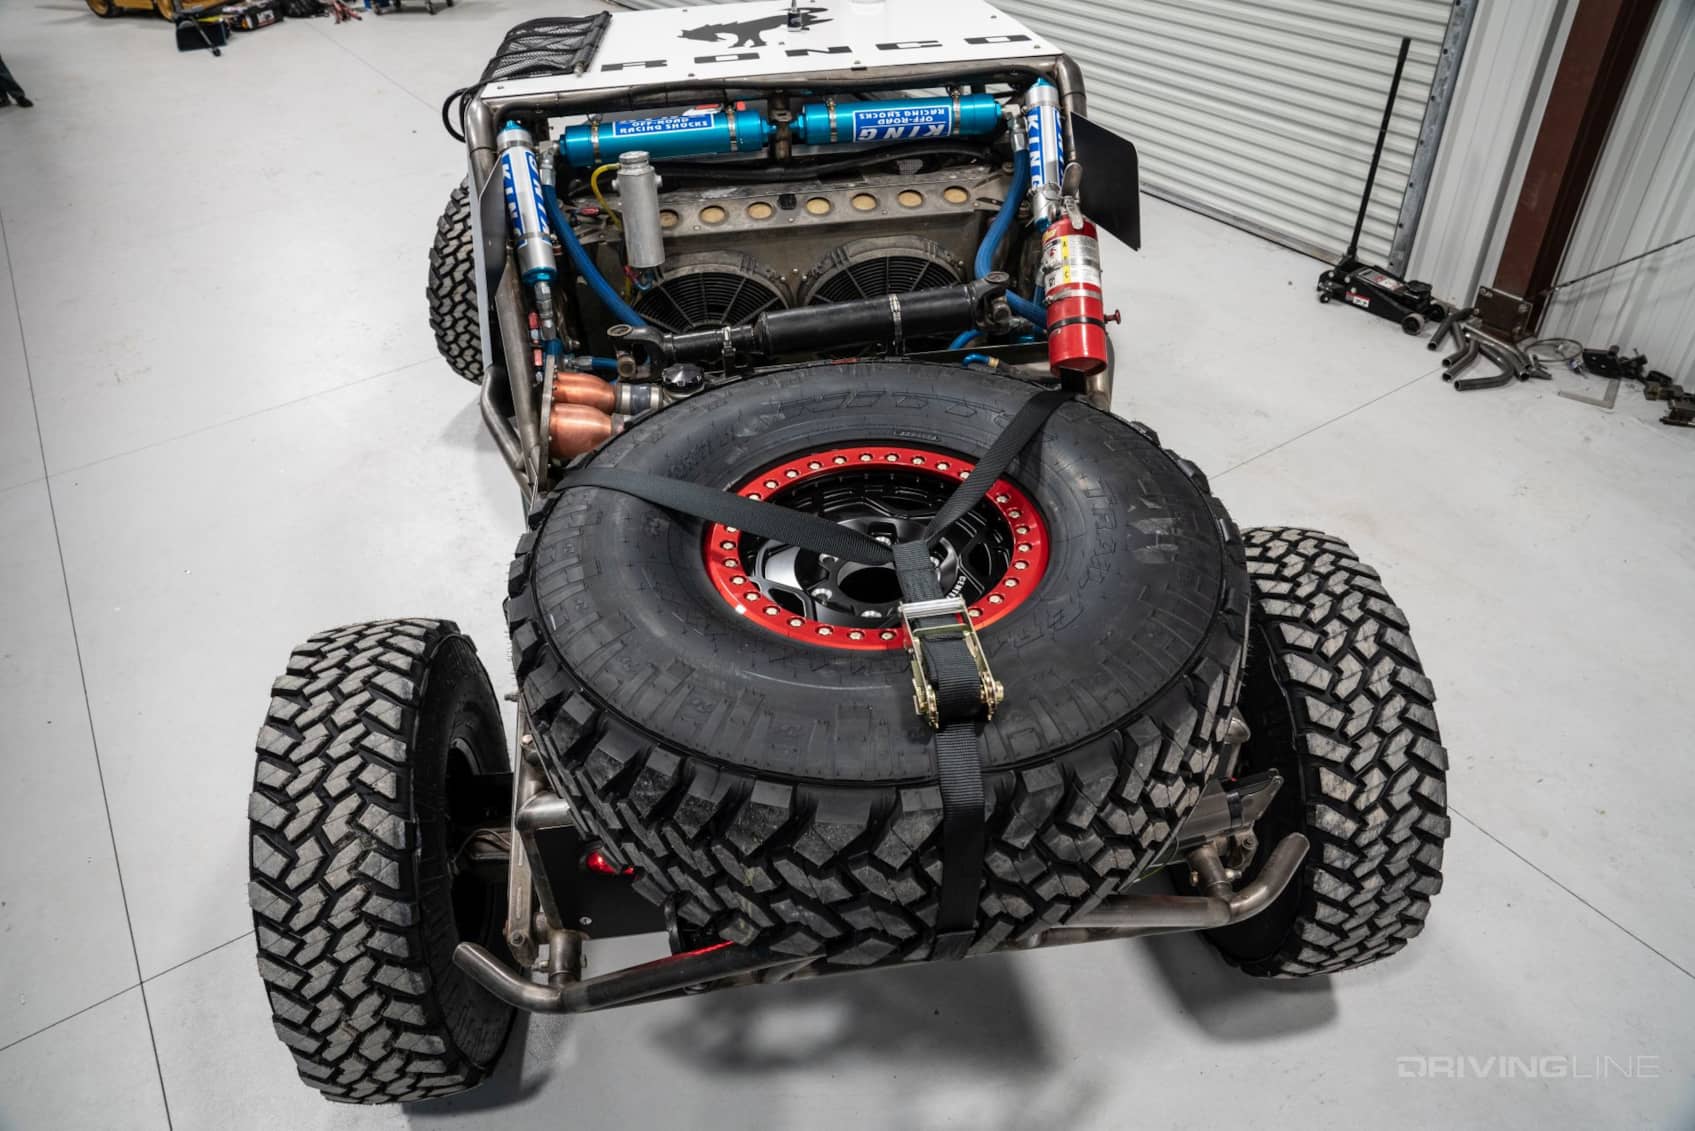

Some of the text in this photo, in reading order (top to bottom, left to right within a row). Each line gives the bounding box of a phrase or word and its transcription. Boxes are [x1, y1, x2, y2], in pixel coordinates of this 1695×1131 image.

[600, 34, 1031, 72] RONCO
[859, 108, 945, 120] RACING SHOCKS
[877, 116, 934, 125] OFF-ROAD
[619, 120, 708, 134] RACING SHOCKS
[857, 124, 945, 140] KING
